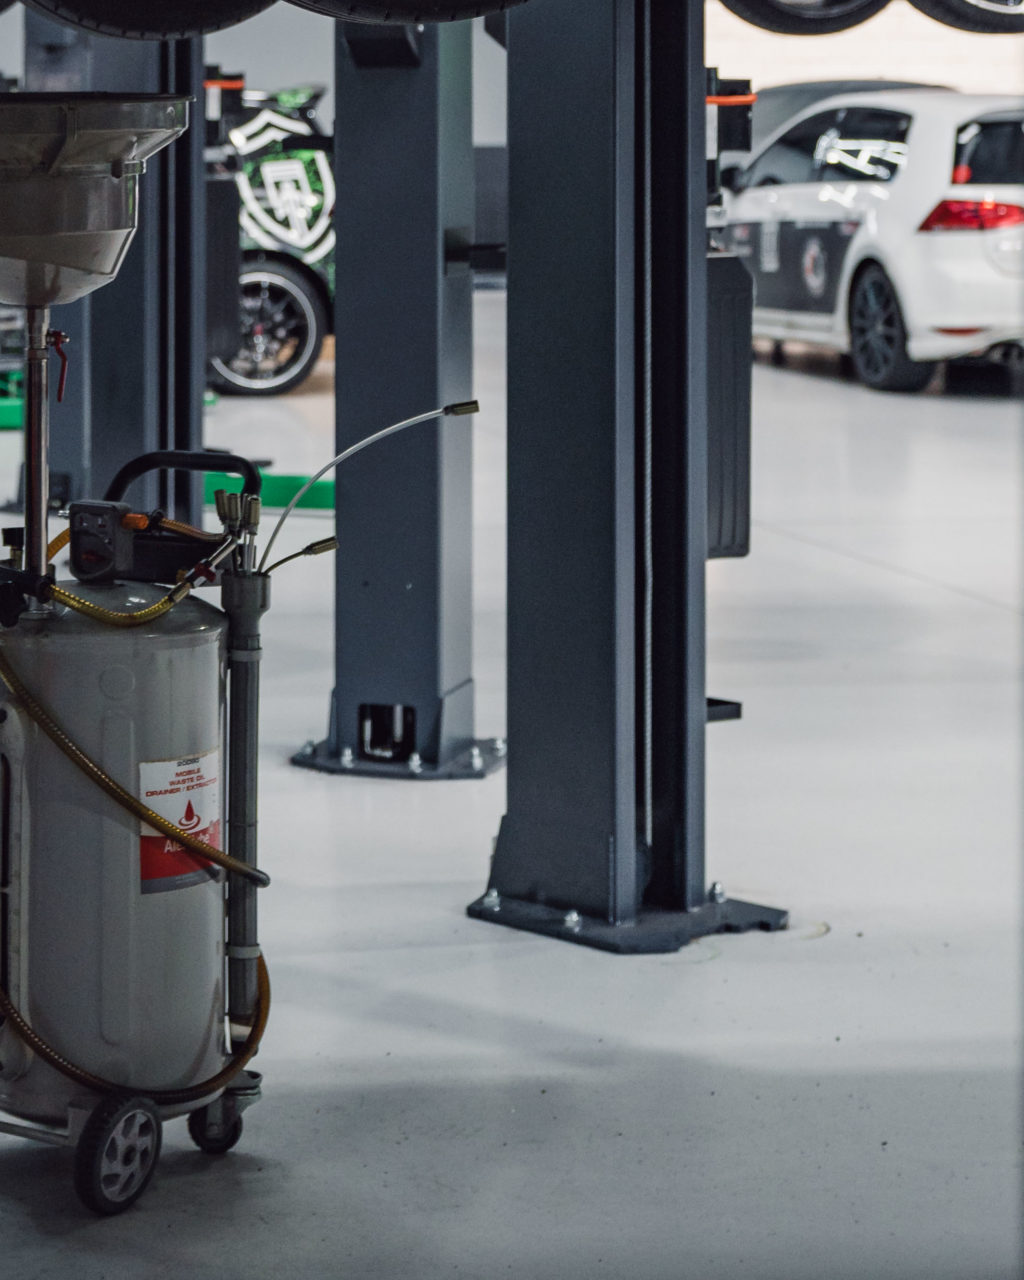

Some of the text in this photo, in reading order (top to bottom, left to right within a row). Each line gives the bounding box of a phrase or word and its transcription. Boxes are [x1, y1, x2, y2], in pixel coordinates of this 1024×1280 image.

[175, 767, 201, 777] MOBILE
[169, 777, 194, 786] WASTE
[146, 788, 181, 797] DRAINER
